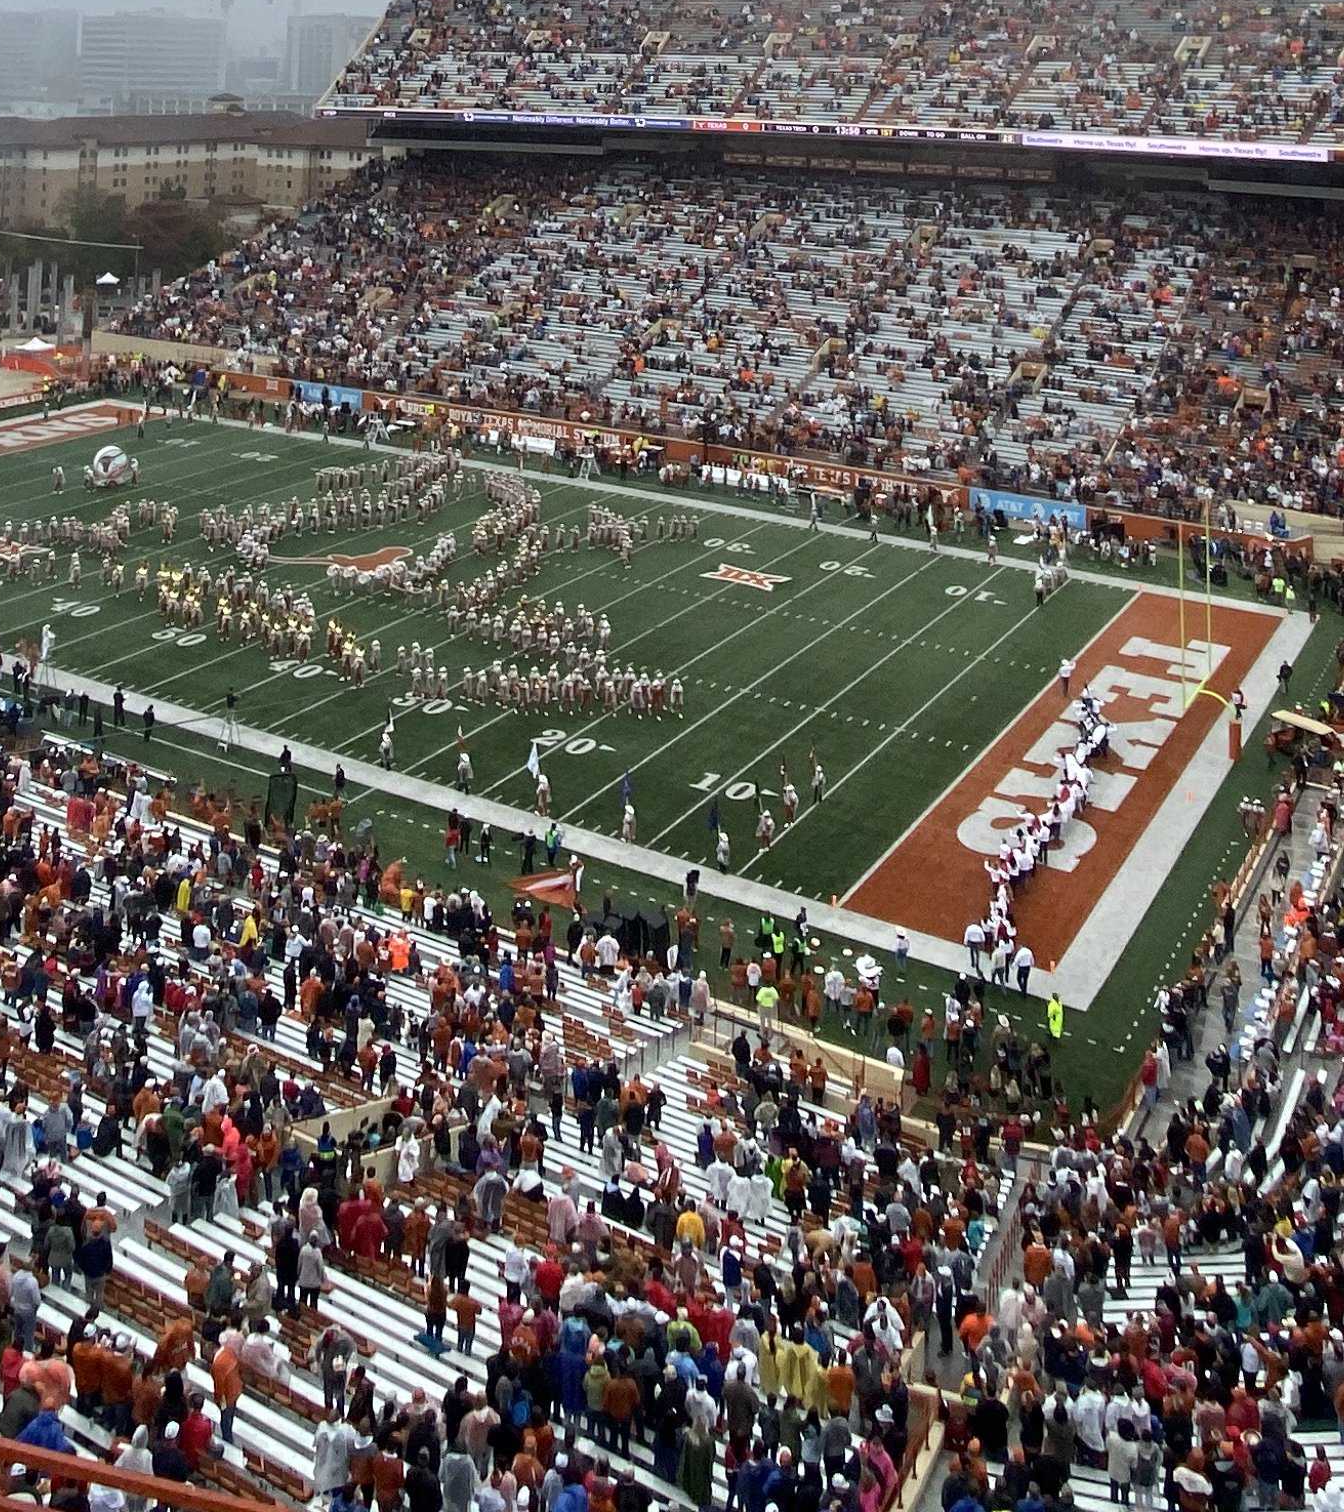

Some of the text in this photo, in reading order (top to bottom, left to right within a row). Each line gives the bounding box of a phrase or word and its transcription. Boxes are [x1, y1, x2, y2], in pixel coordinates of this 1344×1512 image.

[742, 122, 749, 130] 0
[812, 125, 820, 134] 0
[835, 126, 860, 135] 13:50
[1106, 140, 1124, 148] Texas
[1147, 142, 1183, 151] Southwest
[1234, 146, 1254, 154] Texas
[1279, 149, 1317, 158] Southwest
[482, 413, 514, 428] TEXAS
[996, 499, 1024, 513] AT&T
[703, 537, 751, 554] 30
[819, 560, 870, 576] 20
[944, 585, 996, 603] 10
[50, 597, 102, 617] 40
[151, 626, 207, 648] 50
[268, 657, 324, 680] 40
[392, 690, 454, 716] 30
[530, 728, 597, 756] 20
[956, 636, 1232, 873] TEXAS
[688, 771, 758, 802] 10
